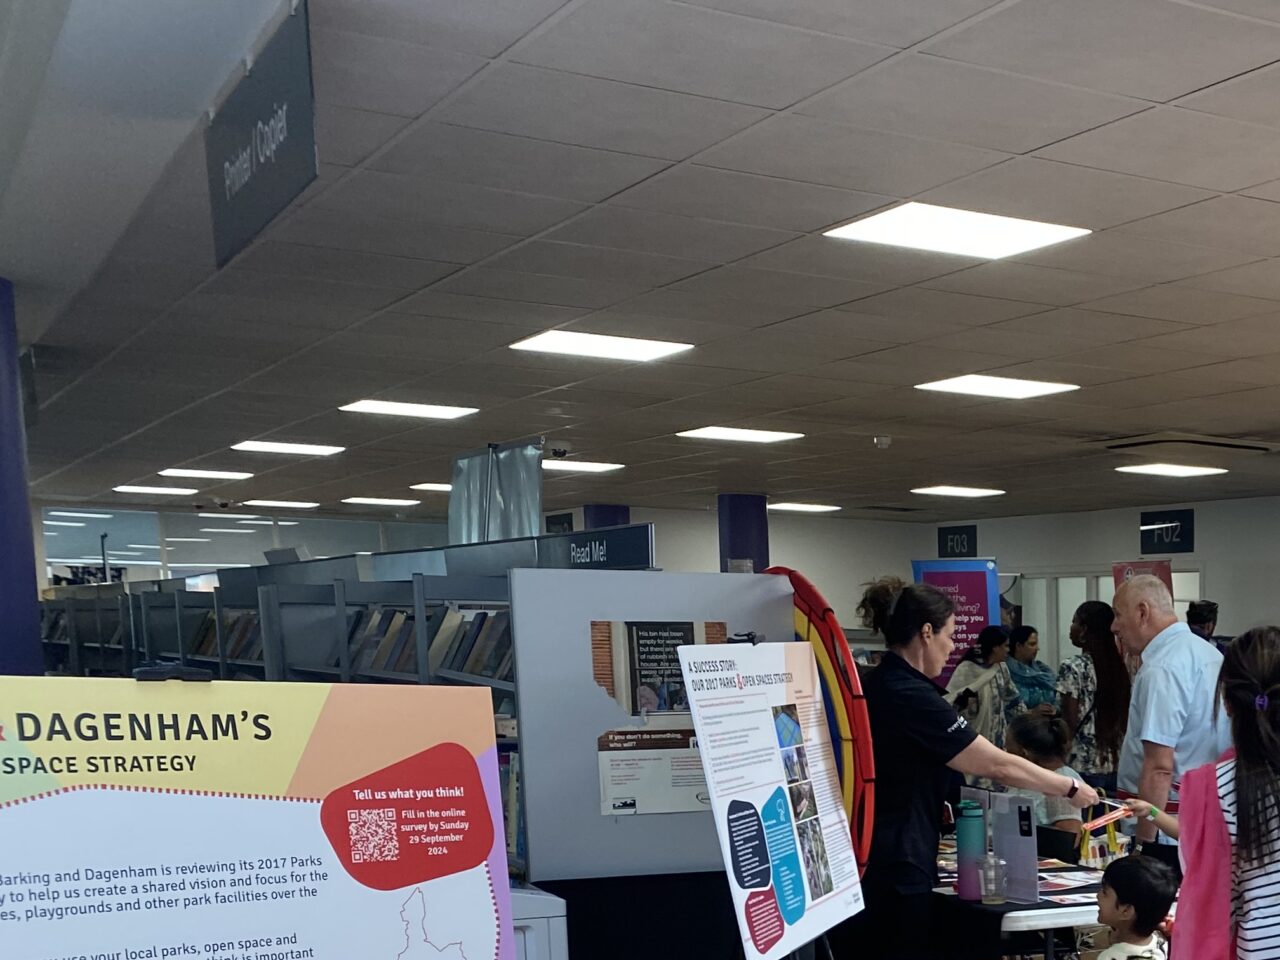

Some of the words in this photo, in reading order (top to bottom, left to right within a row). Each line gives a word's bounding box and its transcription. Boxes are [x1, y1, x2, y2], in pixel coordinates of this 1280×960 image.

[224, 145, 250, 200] Printer
[257, 102, 287, 163] Copier
[1154, 522, 1181, 544] F02
[571, 542, 590, 563] Read
[592, 540, 607, 562] Me!
[947, 534, 968, 554] F03
[688, 661, 693, 673] A
[694, 660, 719, 673] SUCCESS
[692, 679, 705, 691] OUR
[705, 677, 718, 690] 2017
[720, 676, 737, 689] PARKS
[736, 673, 744, 690] &
[742, 674, 756, 687] OPEN
[756, 673, 773, 686] SPACES
[15, 710, 272, 741] DAGENHAM'S
[2, 756, 78, 774] SPACE
[86, 755, 196, 773] STRATEGY
[353, 789, 372, 800] Tell
[375, 790, 386, 799] us
[389, 788, 413, 799] what
[416, 789, 433, 800] you
[435, 787, 464, 797] think!
[402, 810, 415, 818] Fill
[417, 809, 425, 818] in
[427, 809, 439, 817] the
[441, 808, 465, 817] online
[401, 823, 427, 832] survey
[429, 822, 439, 832] by
[440, 821, 469, 831] Sunday
[409, 836, 419, 844] 29
[421, 834, 463, 844] September
[428, 847, 448, 855] 2024
[55, 869, 80, 882] and
[84, 866, 157, 882] Dagenham
[161, 864, 171, 875] is
[175, 861, 236, 875] reviewing
[239, 860, 254, 871] its
[258, 858, 287, 869] 2017
[291, 855, 322, 867] Parks
[10, 891, 24, 902] to
[28, 888, 59, 902] help
[64, 889, 80, 899] us
[84, 884, 127, 898] create
[130, 885, 138, 894] a
[142, 879, 186, 894] shared
[189, 878, 226, 890] vision
[230, 875, 252, 887] and
[255, 873, 287, 885] focus
[290, 871, 306, 883] for
[309, 870, 329, 881] the
[25, 900, 113, 922] playgrounds
[116, 898, 141, 911] and
[145, 896, 180, 910] other
[184, 893, 212, 909] park
[215, 890, 268, 904] facilities
[271, 890, 296, 900] over
[299, 886, 318, 897] the
[125, 945, 158, 960] local
[161, 943, 201, 959] parks,
[204, 941, 235, 954] open
[238, 936, 273, 951] space
[276, 932, 297, 946] and
